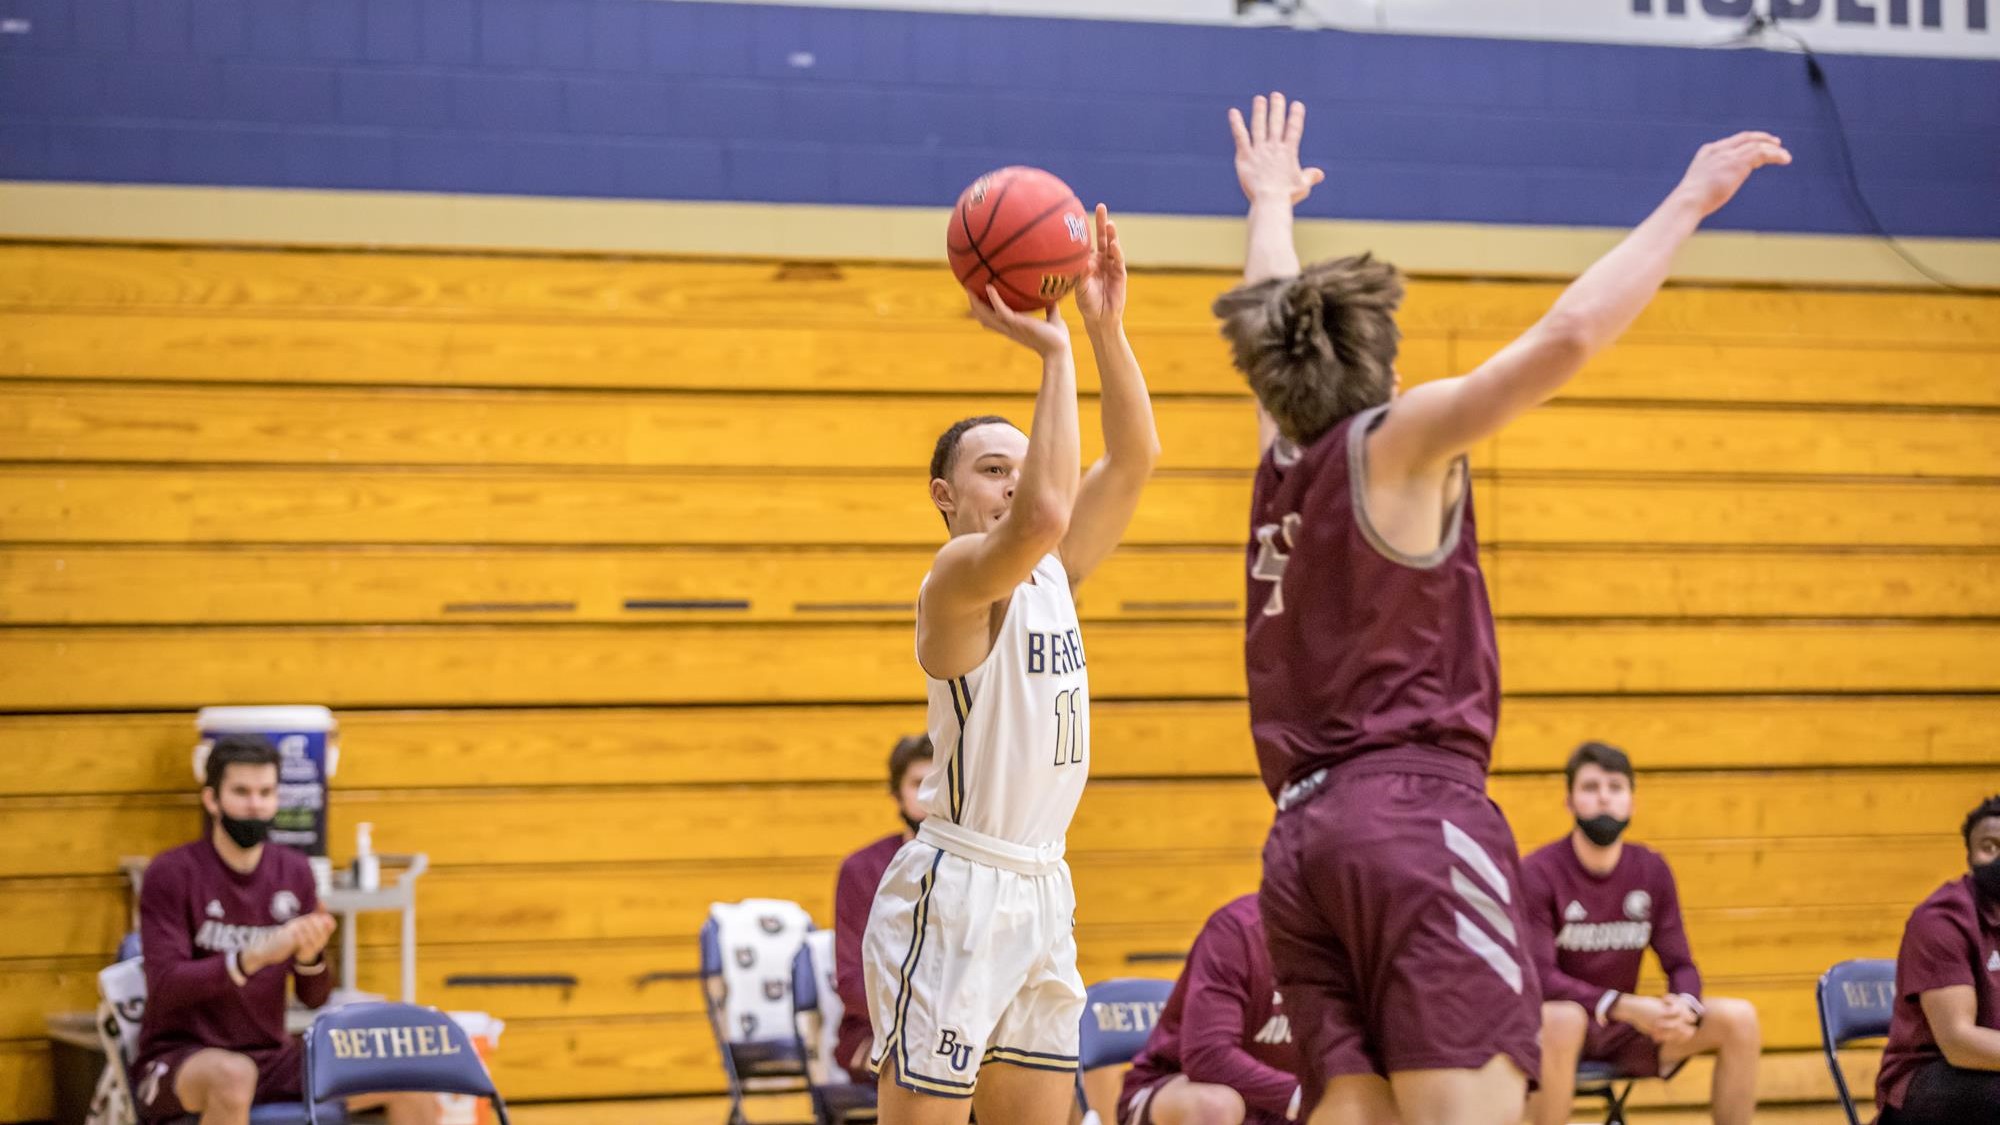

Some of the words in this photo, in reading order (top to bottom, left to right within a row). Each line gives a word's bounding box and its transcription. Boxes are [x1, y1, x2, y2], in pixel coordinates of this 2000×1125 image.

[1054, 687, 1083, 766] 11
[1842, 980, 1897, 1008] BET
[328, 1024, 461, 1059] BETHEL
[936, 1029, 974, 1071] BU
